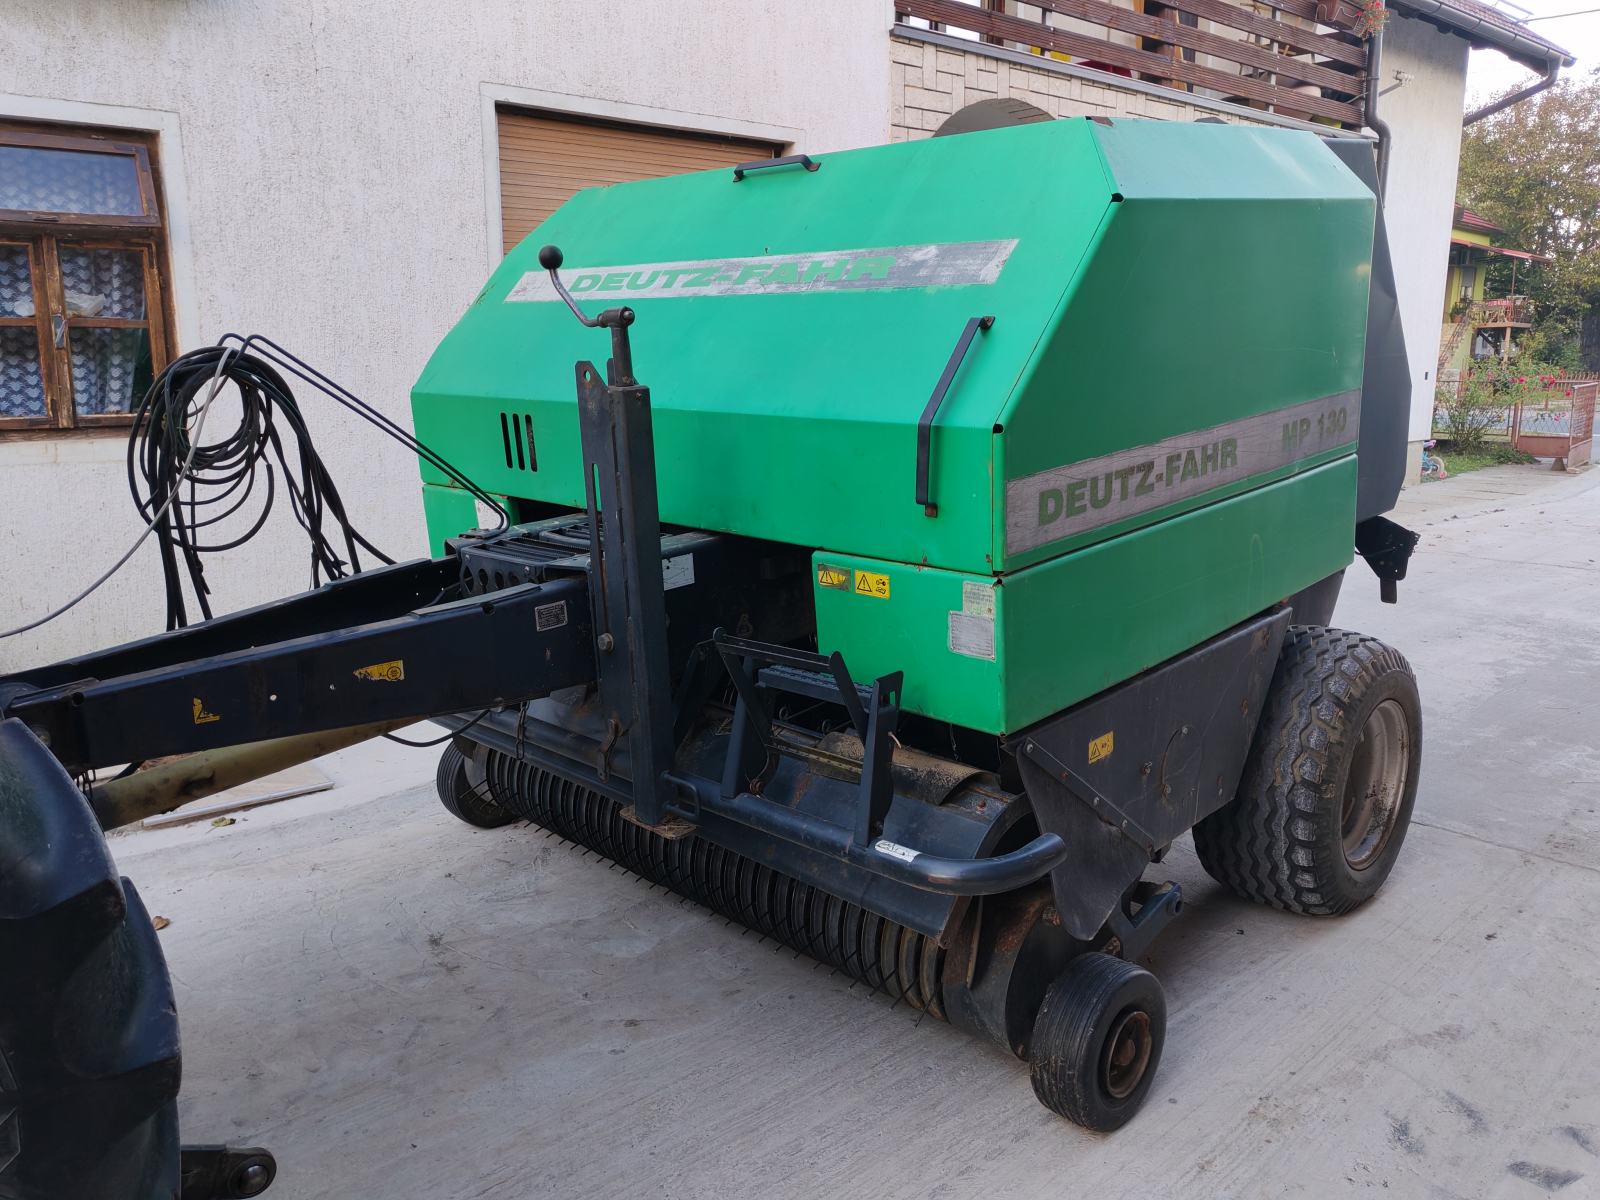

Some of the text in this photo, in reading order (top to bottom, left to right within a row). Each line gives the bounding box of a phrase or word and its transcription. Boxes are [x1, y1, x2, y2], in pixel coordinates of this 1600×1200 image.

[568, 256, 897, 293] DEUTZ-FAHR
[1038, 438, 1238, 526] DEUTZ-FAHR
[1317, 407, 1347, 438] 130
